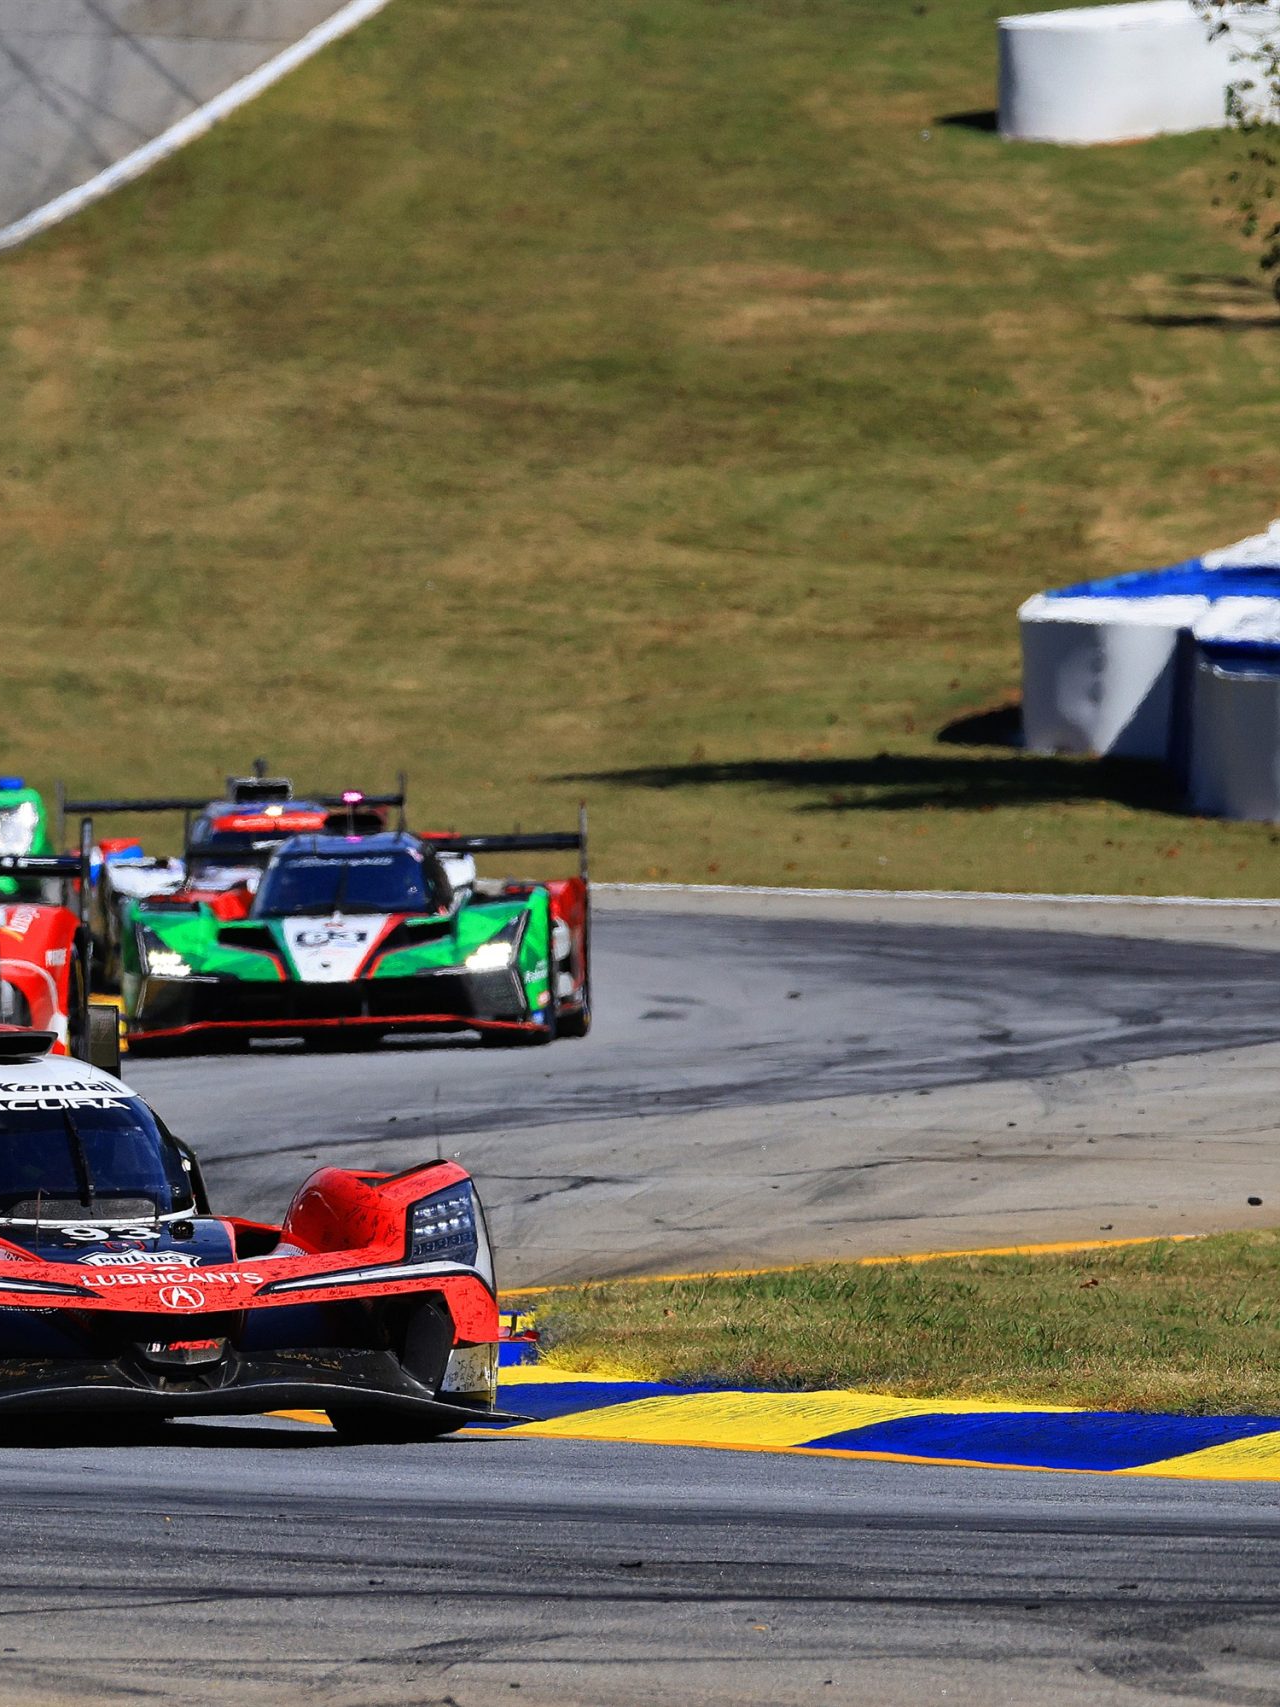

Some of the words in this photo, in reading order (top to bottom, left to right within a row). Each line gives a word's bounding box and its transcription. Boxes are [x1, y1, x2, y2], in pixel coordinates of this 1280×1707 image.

[61, 1226, 161, 1241] 93
[97, 1254, 182, 1265] PHILLIPS
[81, 1272, 264, 1288] LUBRICANTS
